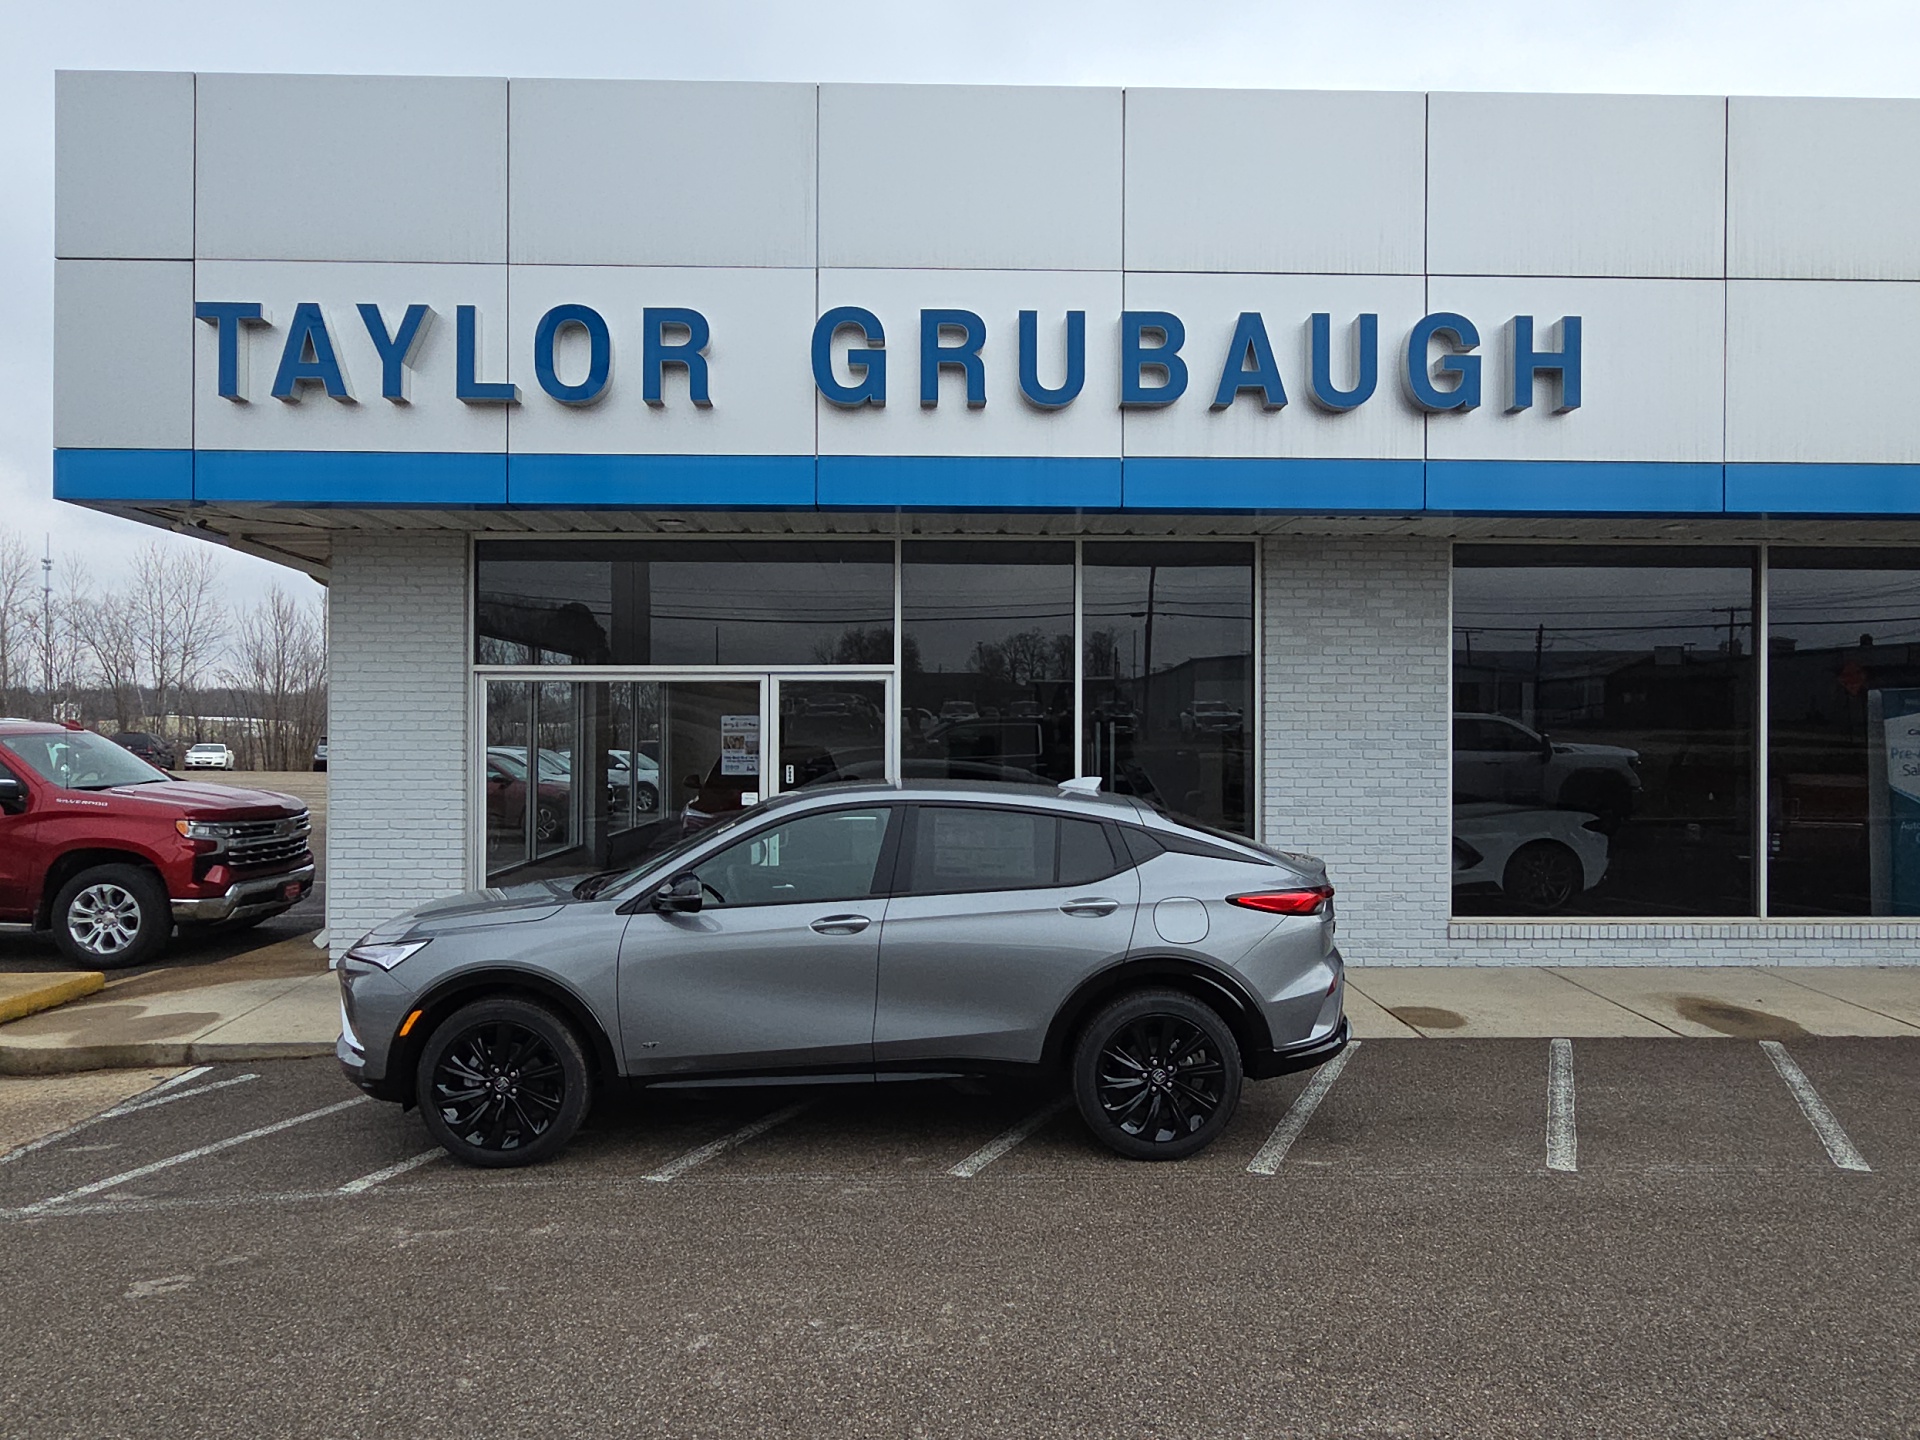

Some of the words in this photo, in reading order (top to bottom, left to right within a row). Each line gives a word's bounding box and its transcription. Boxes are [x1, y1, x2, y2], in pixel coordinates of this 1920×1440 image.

[195, 301, 713, 408] TAYLOR
[811, 306, 1582, 415] GRUBAUGH
[1891, 746, 1920, 759] Pre-
[55, 798, 108, 807] SILVERADO
